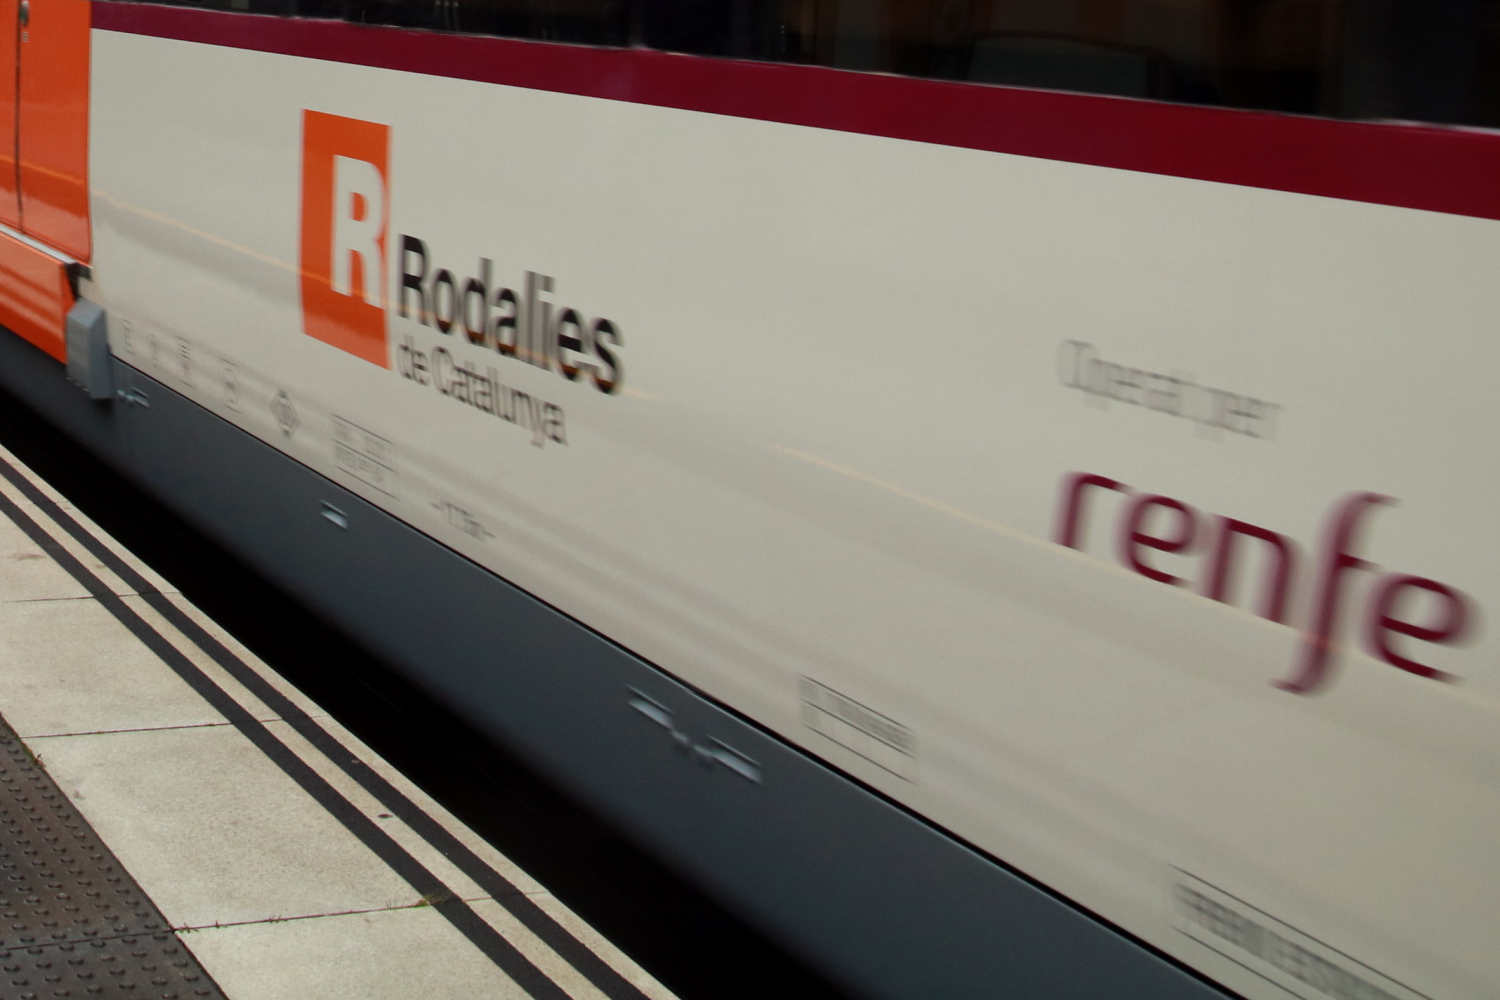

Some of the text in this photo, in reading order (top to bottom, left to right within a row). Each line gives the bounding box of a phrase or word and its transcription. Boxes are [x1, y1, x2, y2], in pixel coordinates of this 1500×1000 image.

[331, 153, 388, 311] R
[395, 335, 569, 449] de Catalunya
[396, 233, 626, 396] Rodalies
[1052, 470, 1482, 697] renfe
